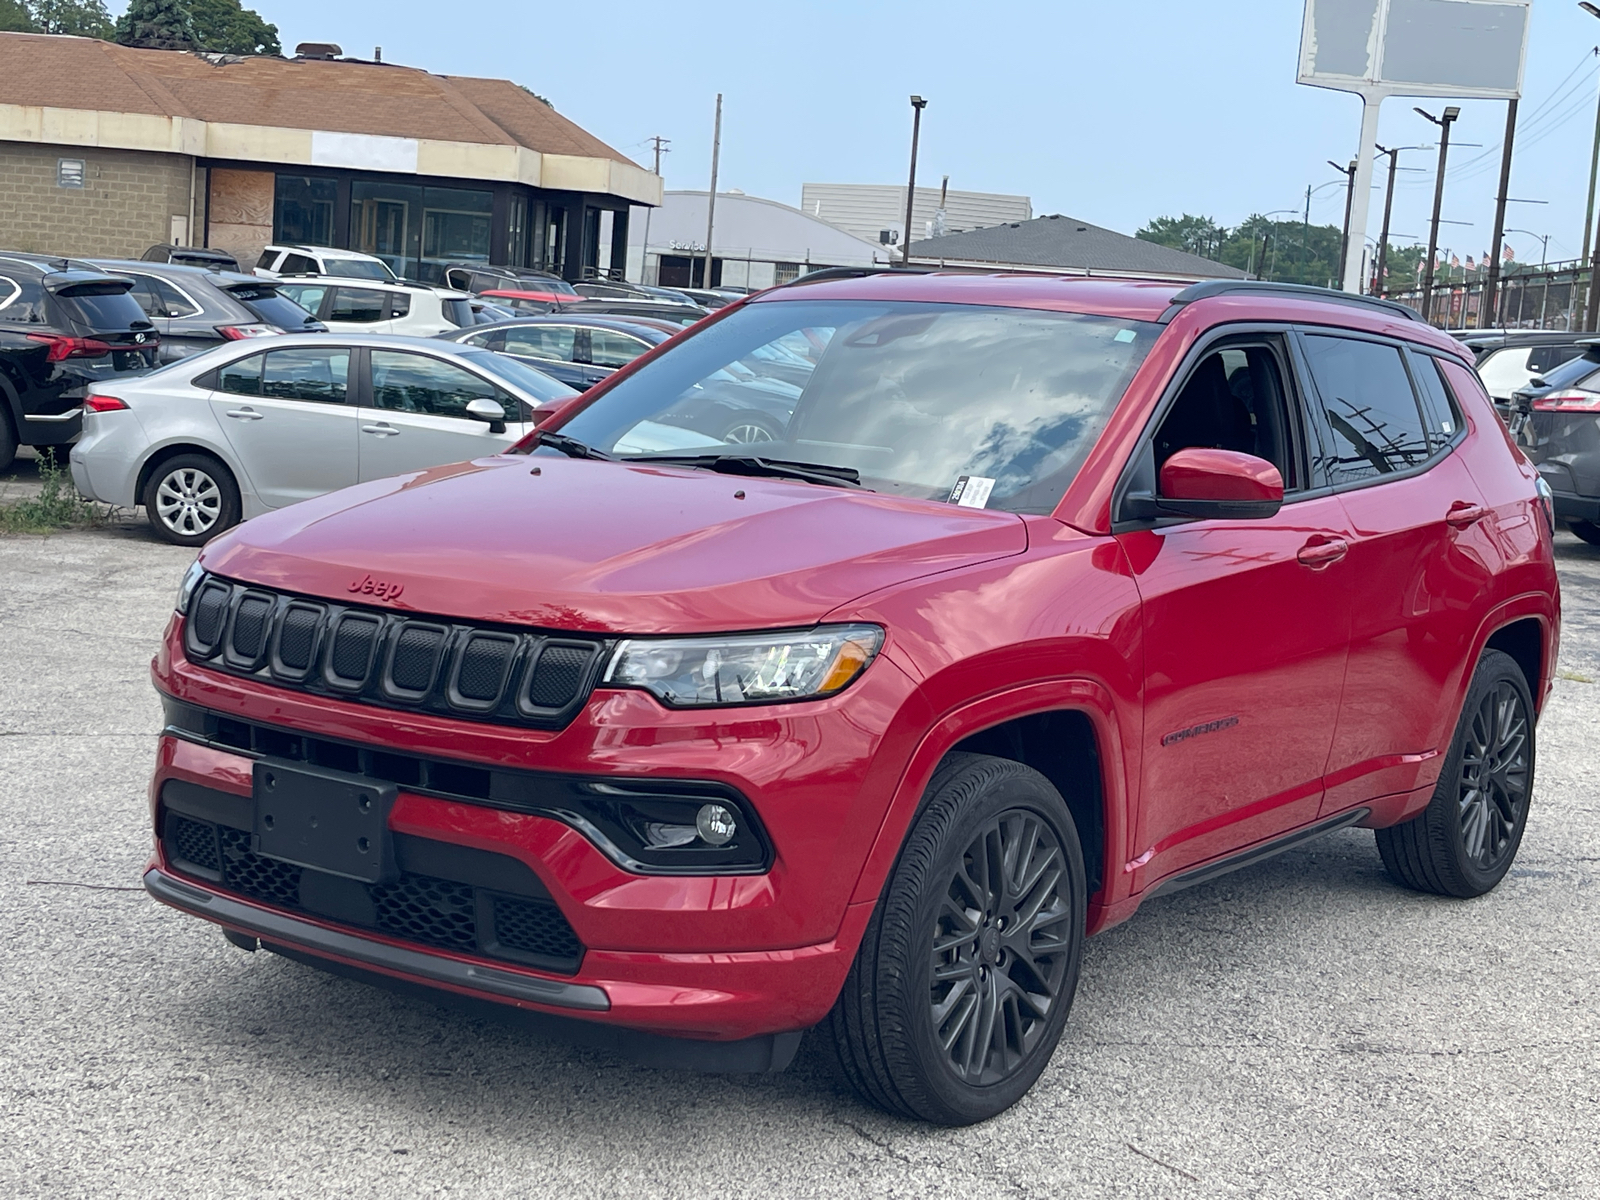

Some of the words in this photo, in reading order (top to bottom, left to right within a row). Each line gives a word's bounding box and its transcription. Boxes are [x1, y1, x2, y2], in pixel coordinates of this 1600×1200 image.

[669, 239, 706, 251] Service
[347, 574, 404, 602] Jeep
[1160, 714, 1240, 746] COMPASS
